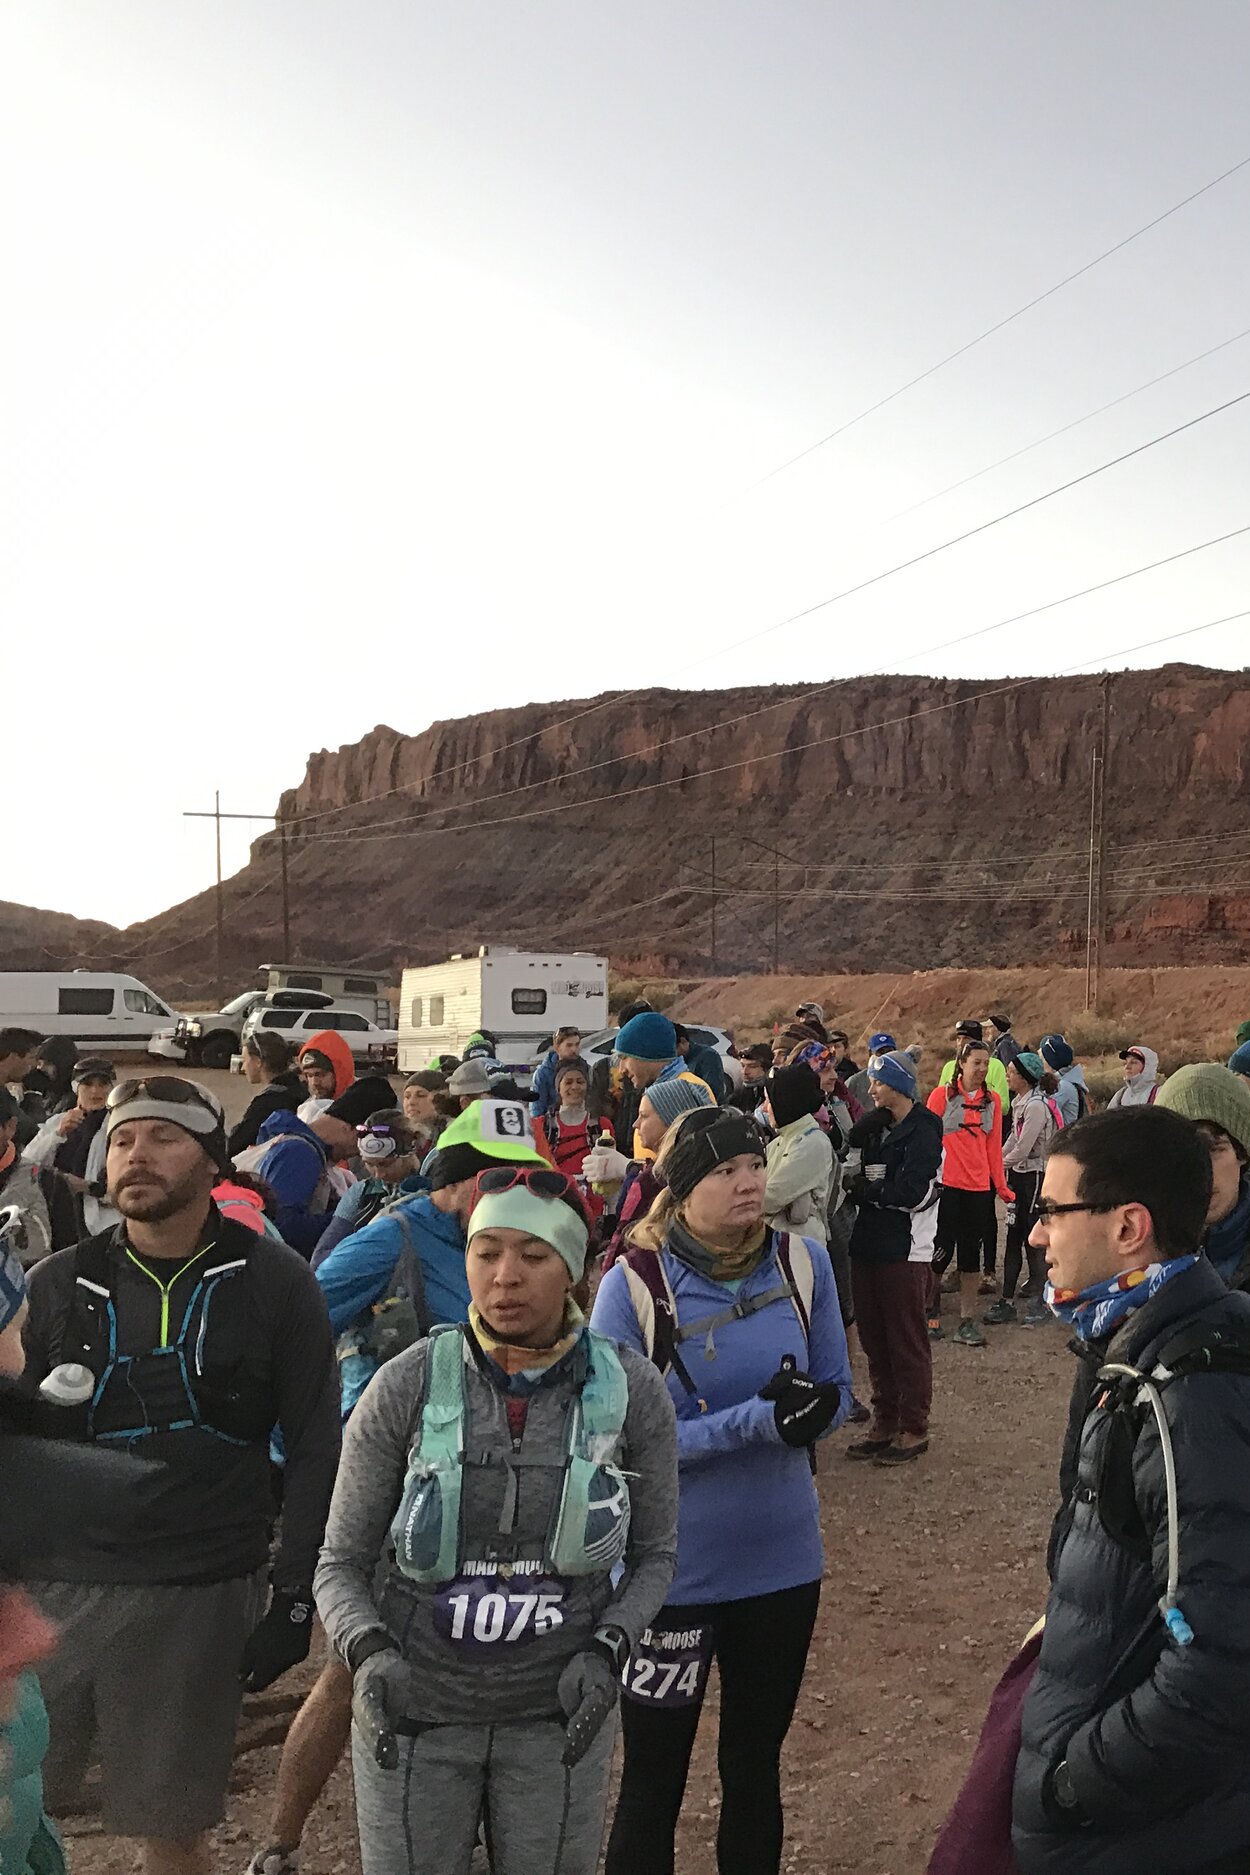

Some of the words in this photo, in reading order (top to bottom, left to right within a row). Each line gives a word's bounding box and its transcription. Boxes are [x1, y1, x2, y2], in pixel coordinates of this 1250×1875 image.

[462, 1560, 498, 1576] MAD
[448, 1593, 564, 1643] 1075
[661, 1629, 702, 1650] MOOSE
